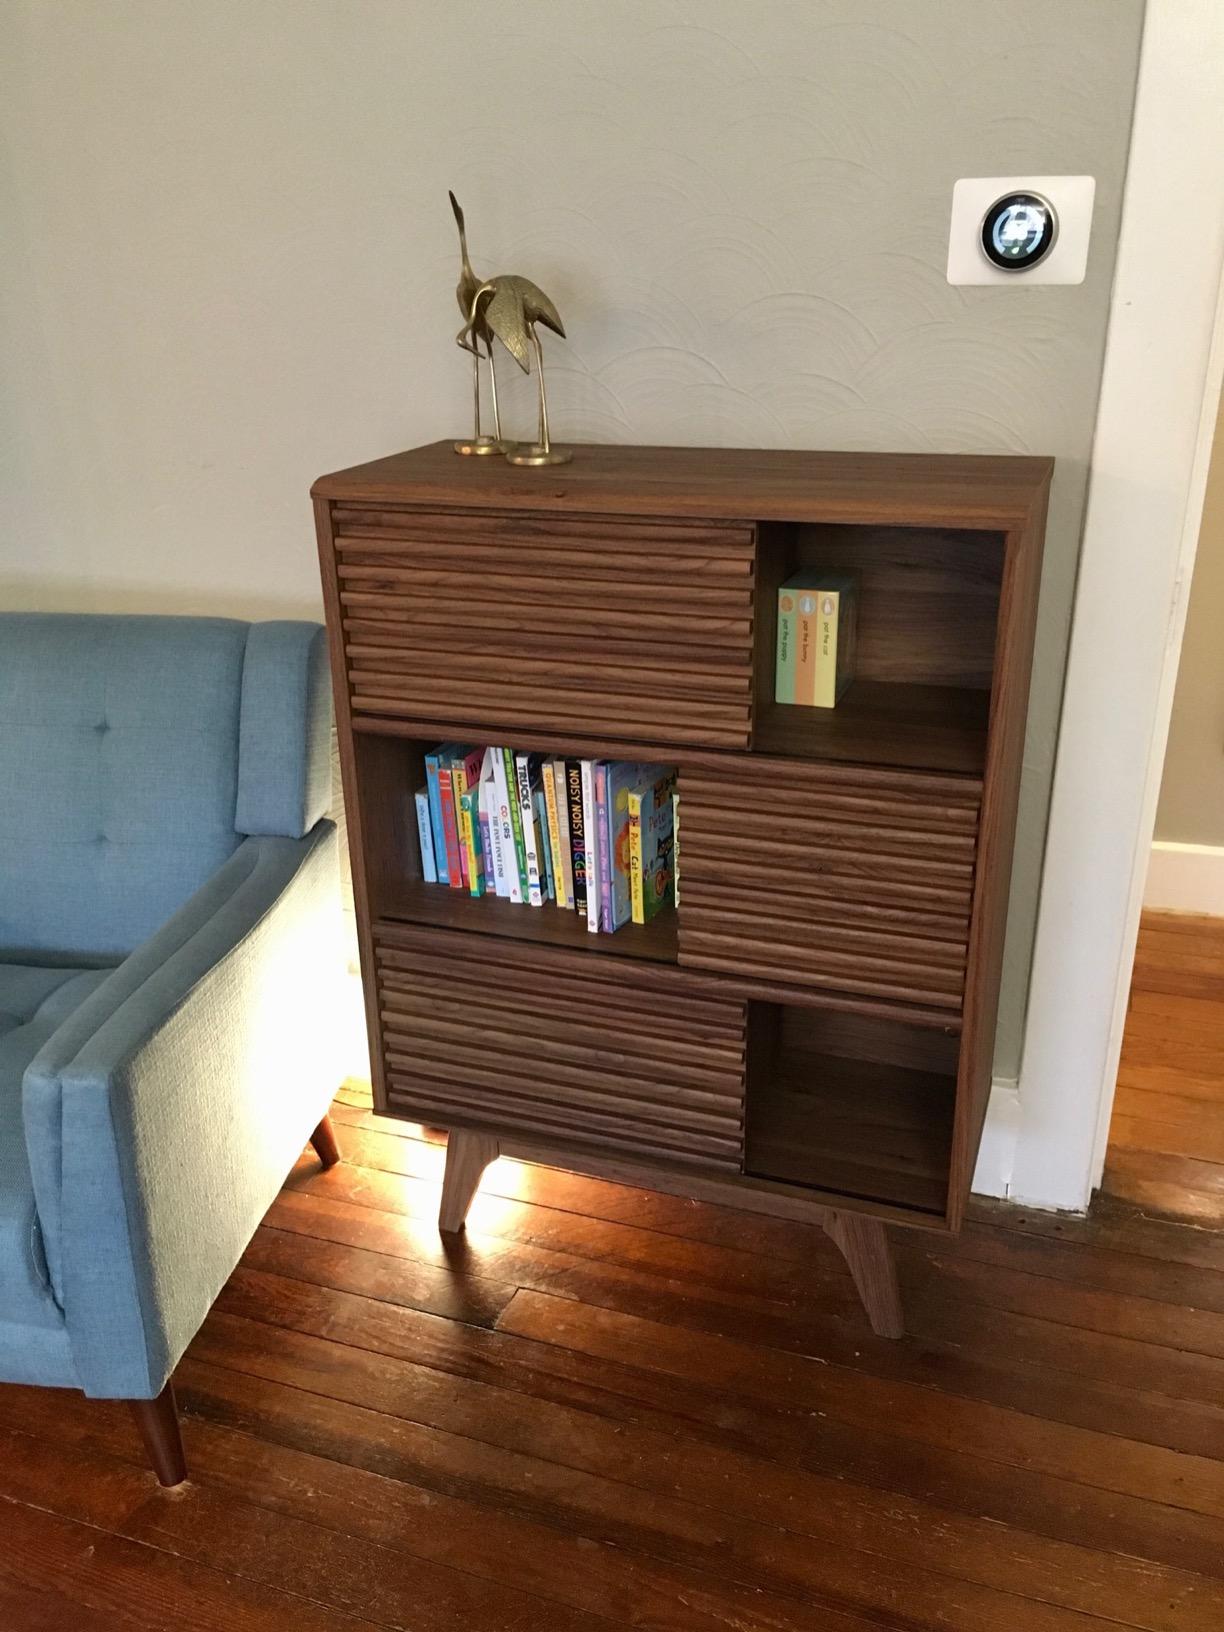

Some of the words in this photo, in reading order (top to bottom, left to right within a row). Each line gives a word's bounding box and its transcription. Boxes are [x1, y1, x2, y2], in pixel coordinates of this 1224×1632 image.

[518, 765, 531, 810] TRUCKS
[546, 772, 556, 809] QUANTUM
[569, 769, 580, 804] NOISY
[550, 810, 559, 840] PHYSICS
[571, 804, 584, 838] NOISY
[630, 831, 639, 851] Pete
[573, 839, 588, 886] DIGGER
[631, 855, 640, 871] Cat
